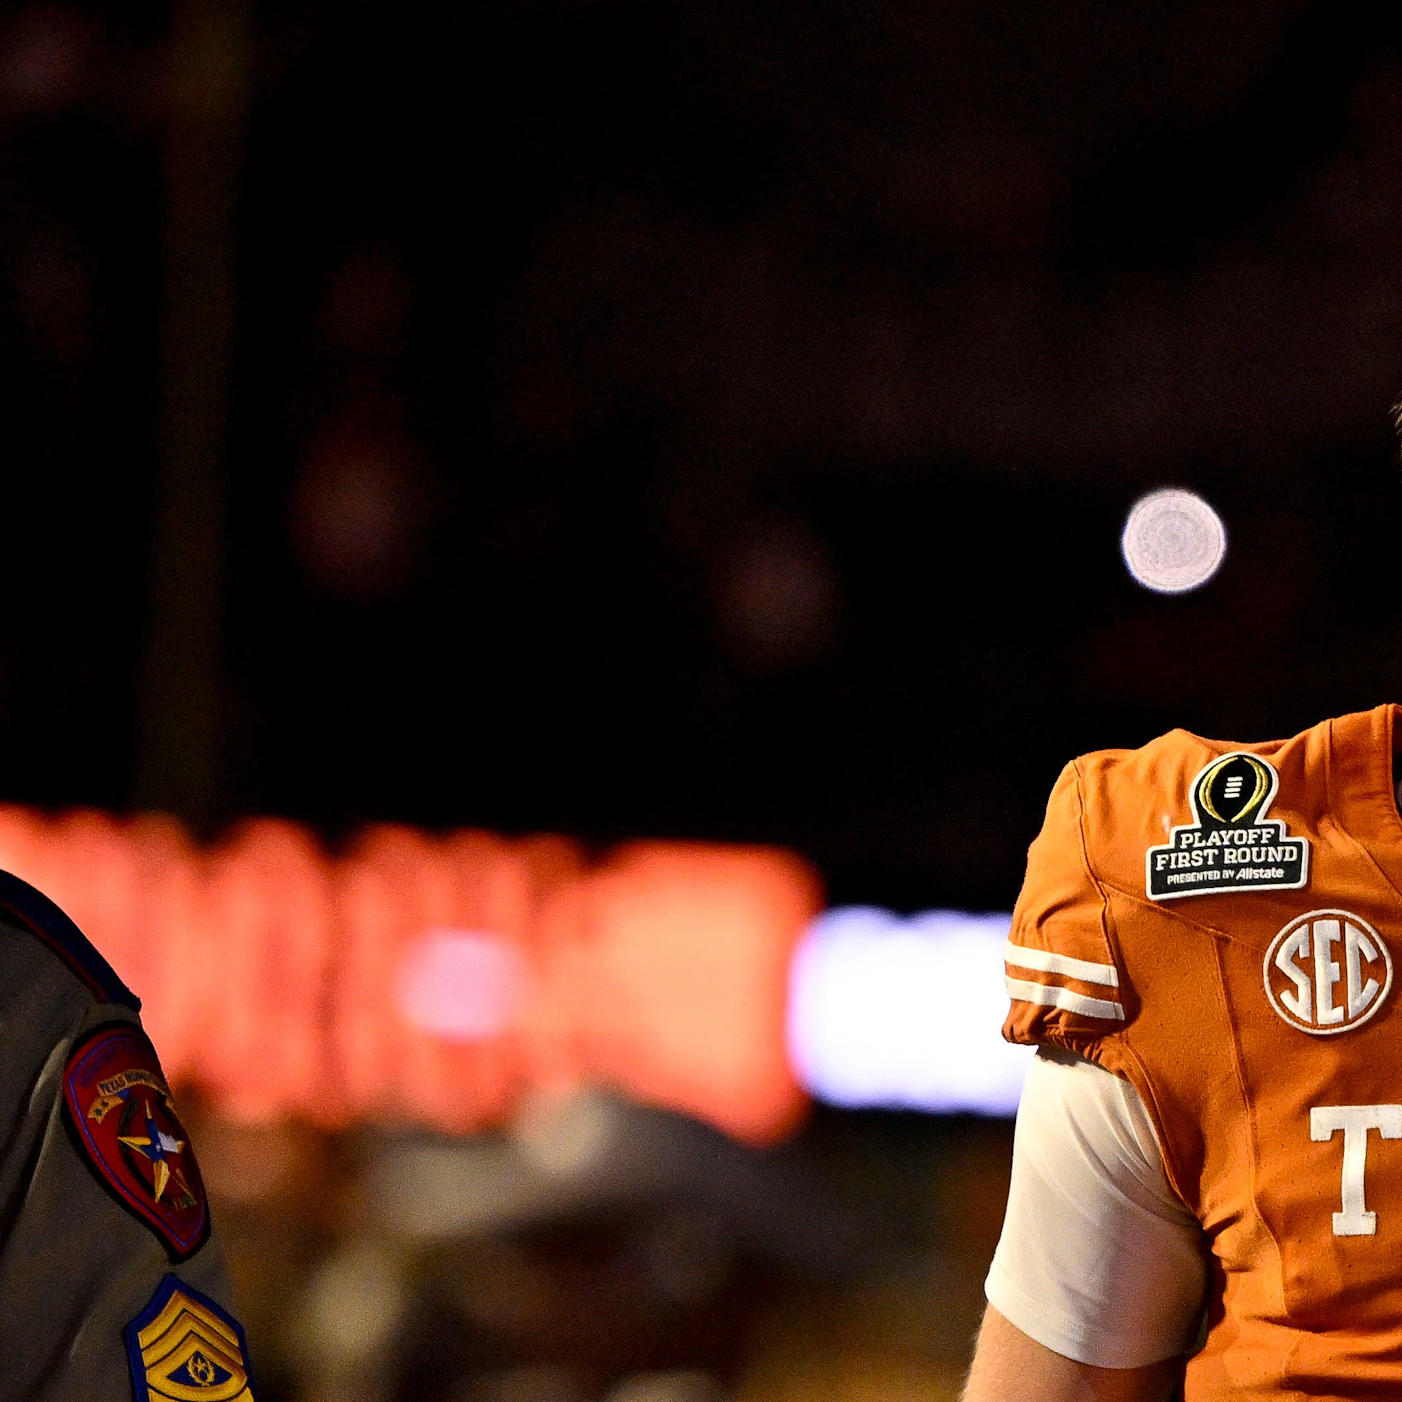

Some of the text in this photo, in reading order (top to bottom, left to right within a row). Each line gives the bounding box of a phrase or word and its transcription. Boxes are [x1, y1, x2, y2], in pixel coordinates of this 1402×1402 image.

[1179, 828, 1275, 849] PLAYOFF
[1155, 845, 1298, 871] FIRST ROUND
[1166, 867, 1284, 885] PRESENTED BY Allstate
[1275, 919, 1380, 1026] SEC
